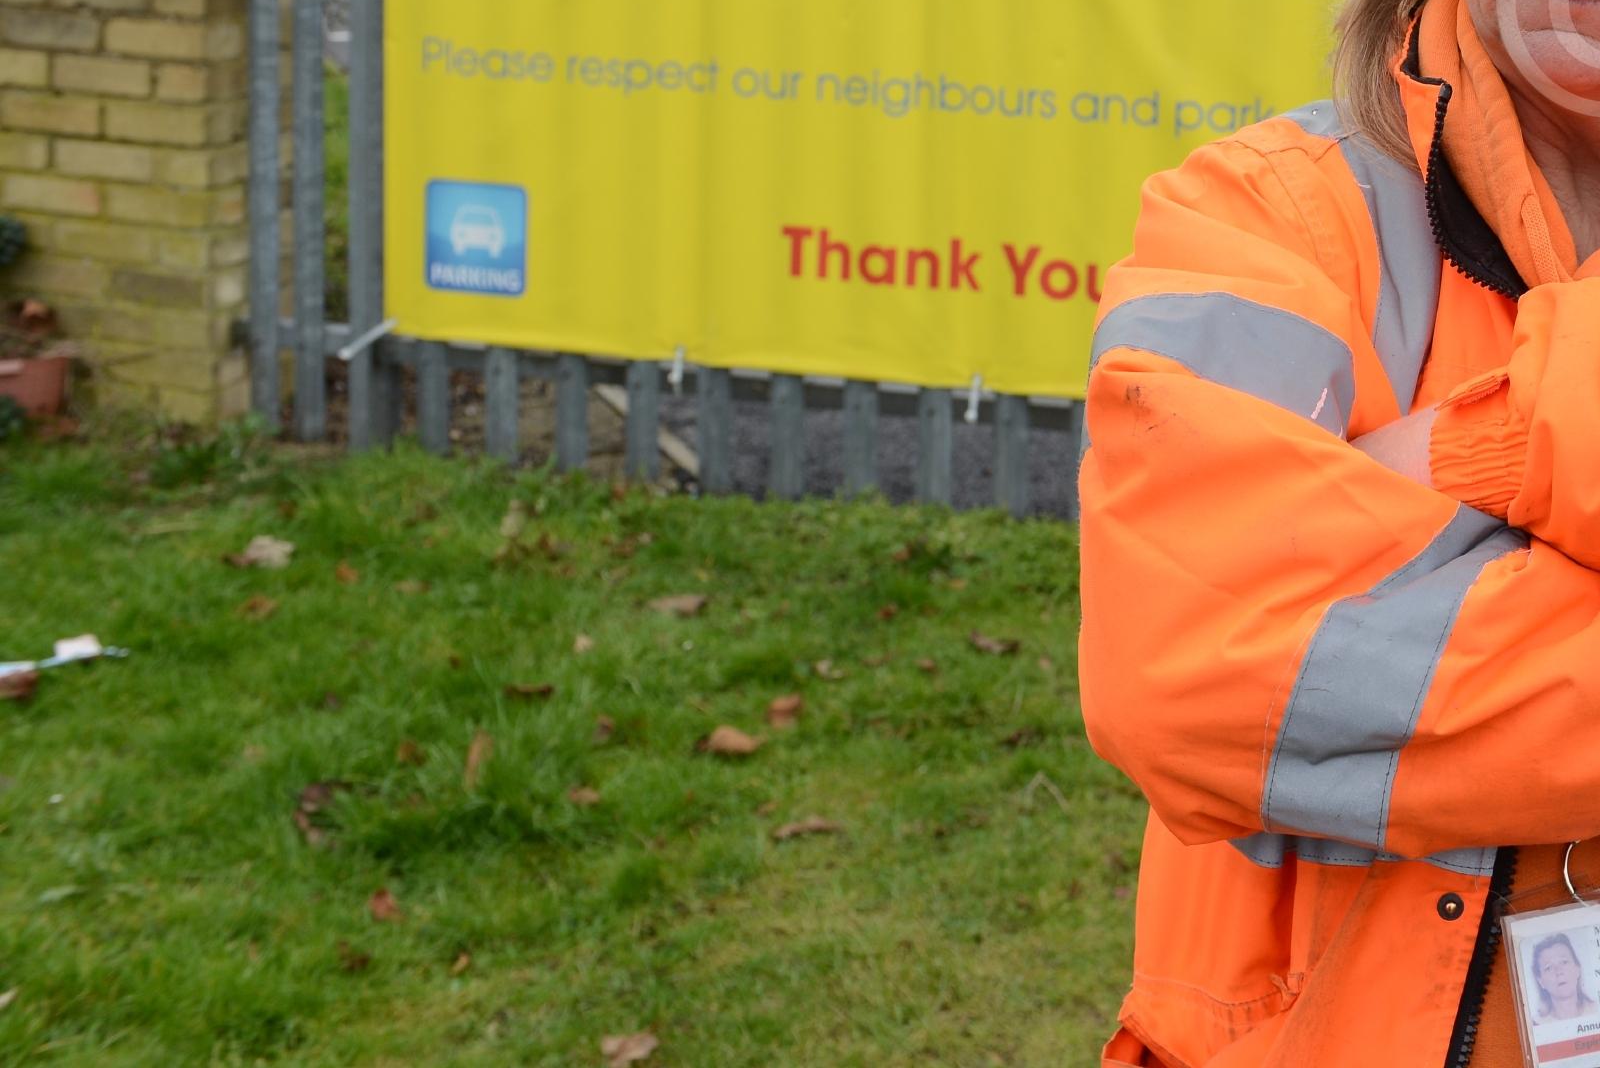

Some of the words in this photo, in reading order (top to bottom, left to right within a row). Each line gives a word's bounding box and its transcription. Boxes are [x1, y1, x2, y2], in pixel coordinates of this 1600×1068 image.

[421, 35, 555, 82] Please
[566, 54, 718, 96] respect
[731, 66, 803, 100] our
[815, 69, 1057, 119] neighbours
[1070, 90, 1161, 127] and
[782, 225, 980, 291] Thank
